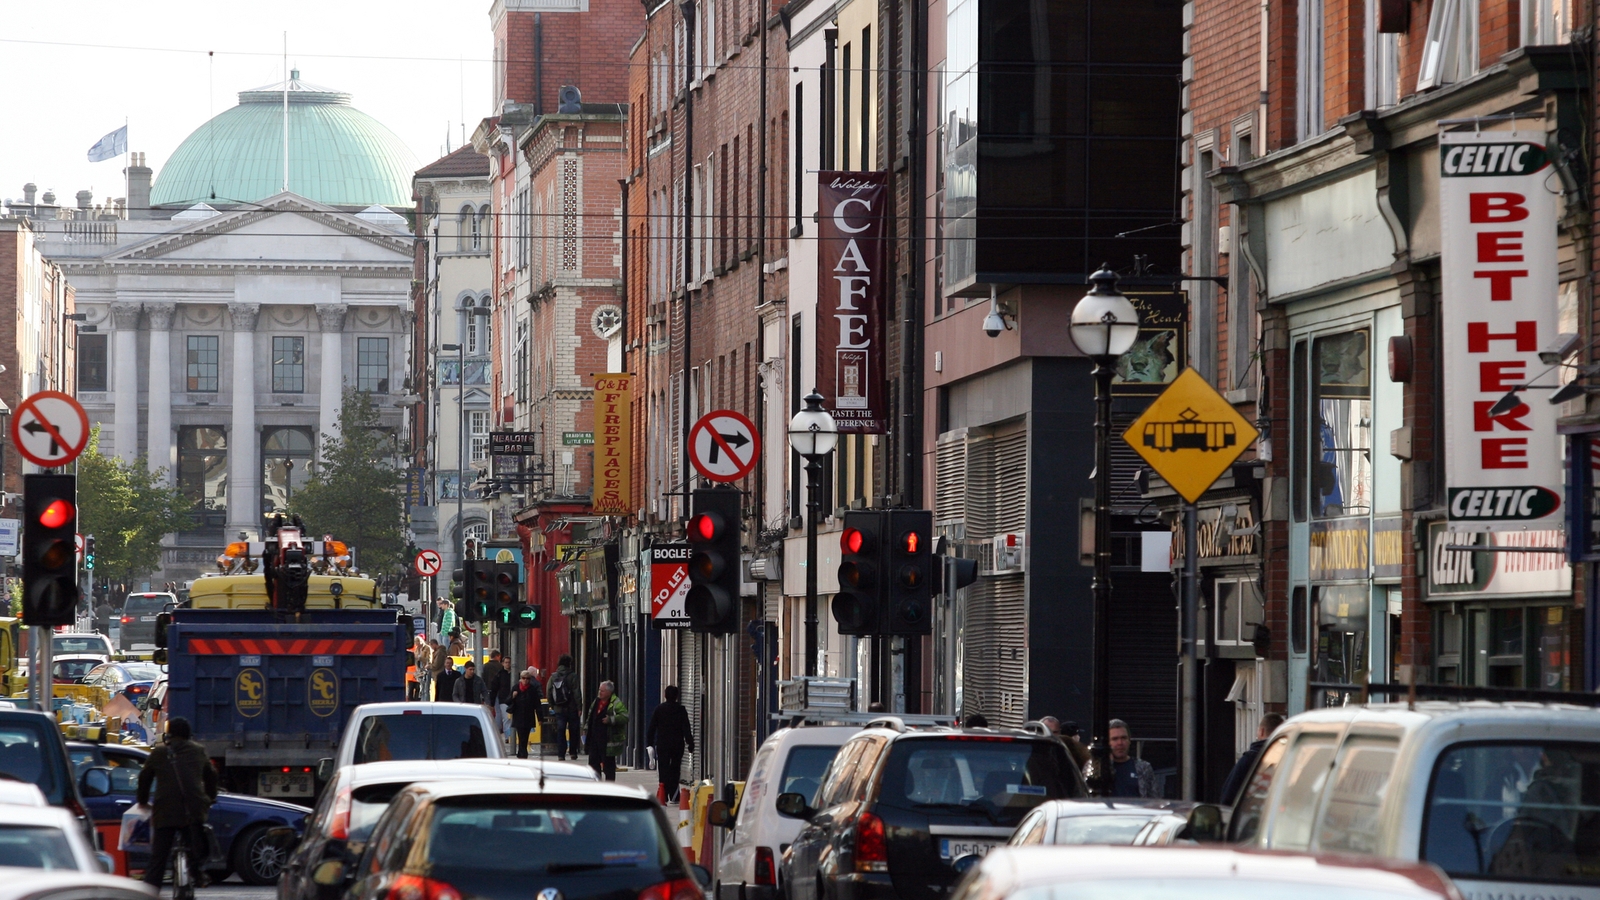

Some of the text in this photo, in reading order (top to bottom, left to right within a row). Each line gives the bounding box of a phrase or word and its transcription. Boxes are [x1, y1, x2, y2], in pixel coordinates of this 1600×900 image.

[1444, 144, 1530, 174] CELTIC
[833, 198, 871, 348] CAFE
[1129, 298, 1152, 310] The
[1144, 310, 1182, 324] Head
[603, 393, 621, 500] FIREPLACES
[1451, 489, 1538, 517] CELTIC
[654, 549, 687, 558] BOGLE
[1310, 529, 1403, 571] O'CONNOR'S WORKW
[1433, 531, 1477, 585] CELTIC
[654, 566, 686, 605] TO LET
